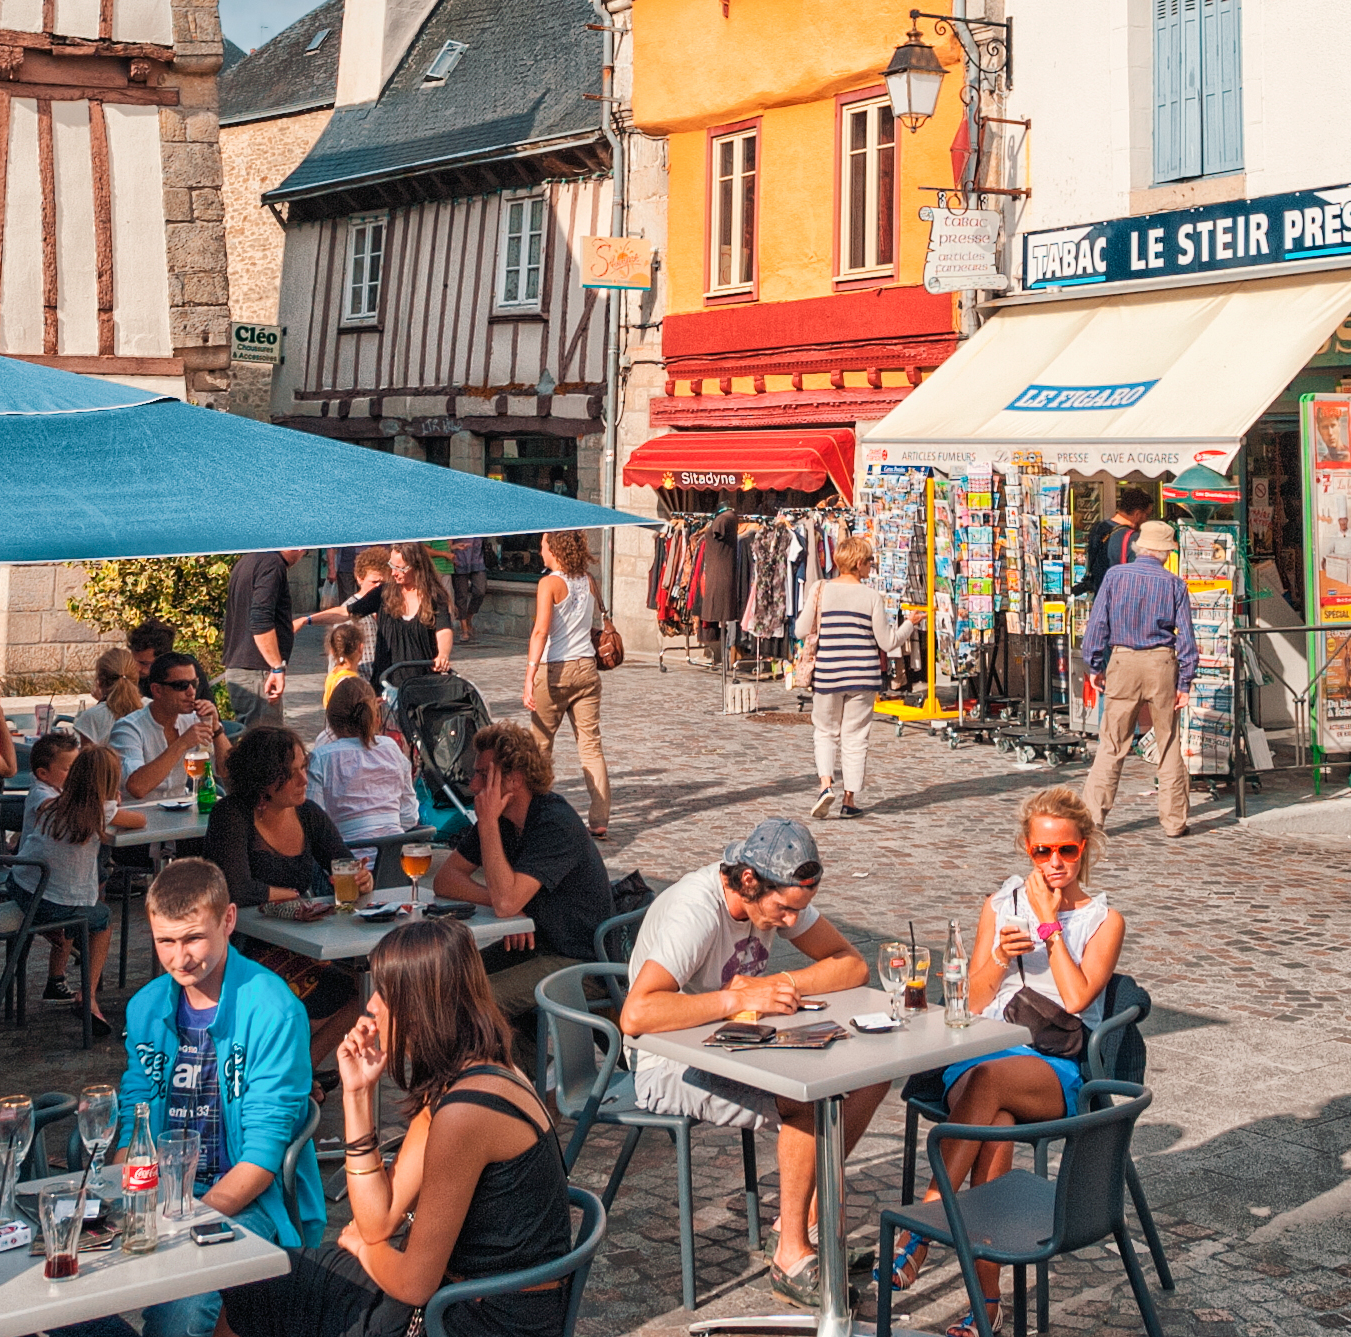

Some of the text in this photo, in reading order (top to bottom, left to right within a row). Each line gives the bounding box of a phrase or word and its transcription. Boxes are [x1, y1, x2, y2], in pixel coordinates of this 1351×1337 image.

[1032, 237, 1107, 278] TABAC
[1130, 227, 1165, 271] LE
[1177, 213, 1270, 265] STEIR
[235, 326, 278, 345] Cléo
[1014, 385, 1146, 408] LE FIGARO
[901, 451, 977, 462] ARTICLES FUMEURS
[1057, 452, 1180, 464] PRESSE CAVE A CIGARES
[681, 472, 736, 486] Sitadyne
[196, 1104, 210, 1117] 33
